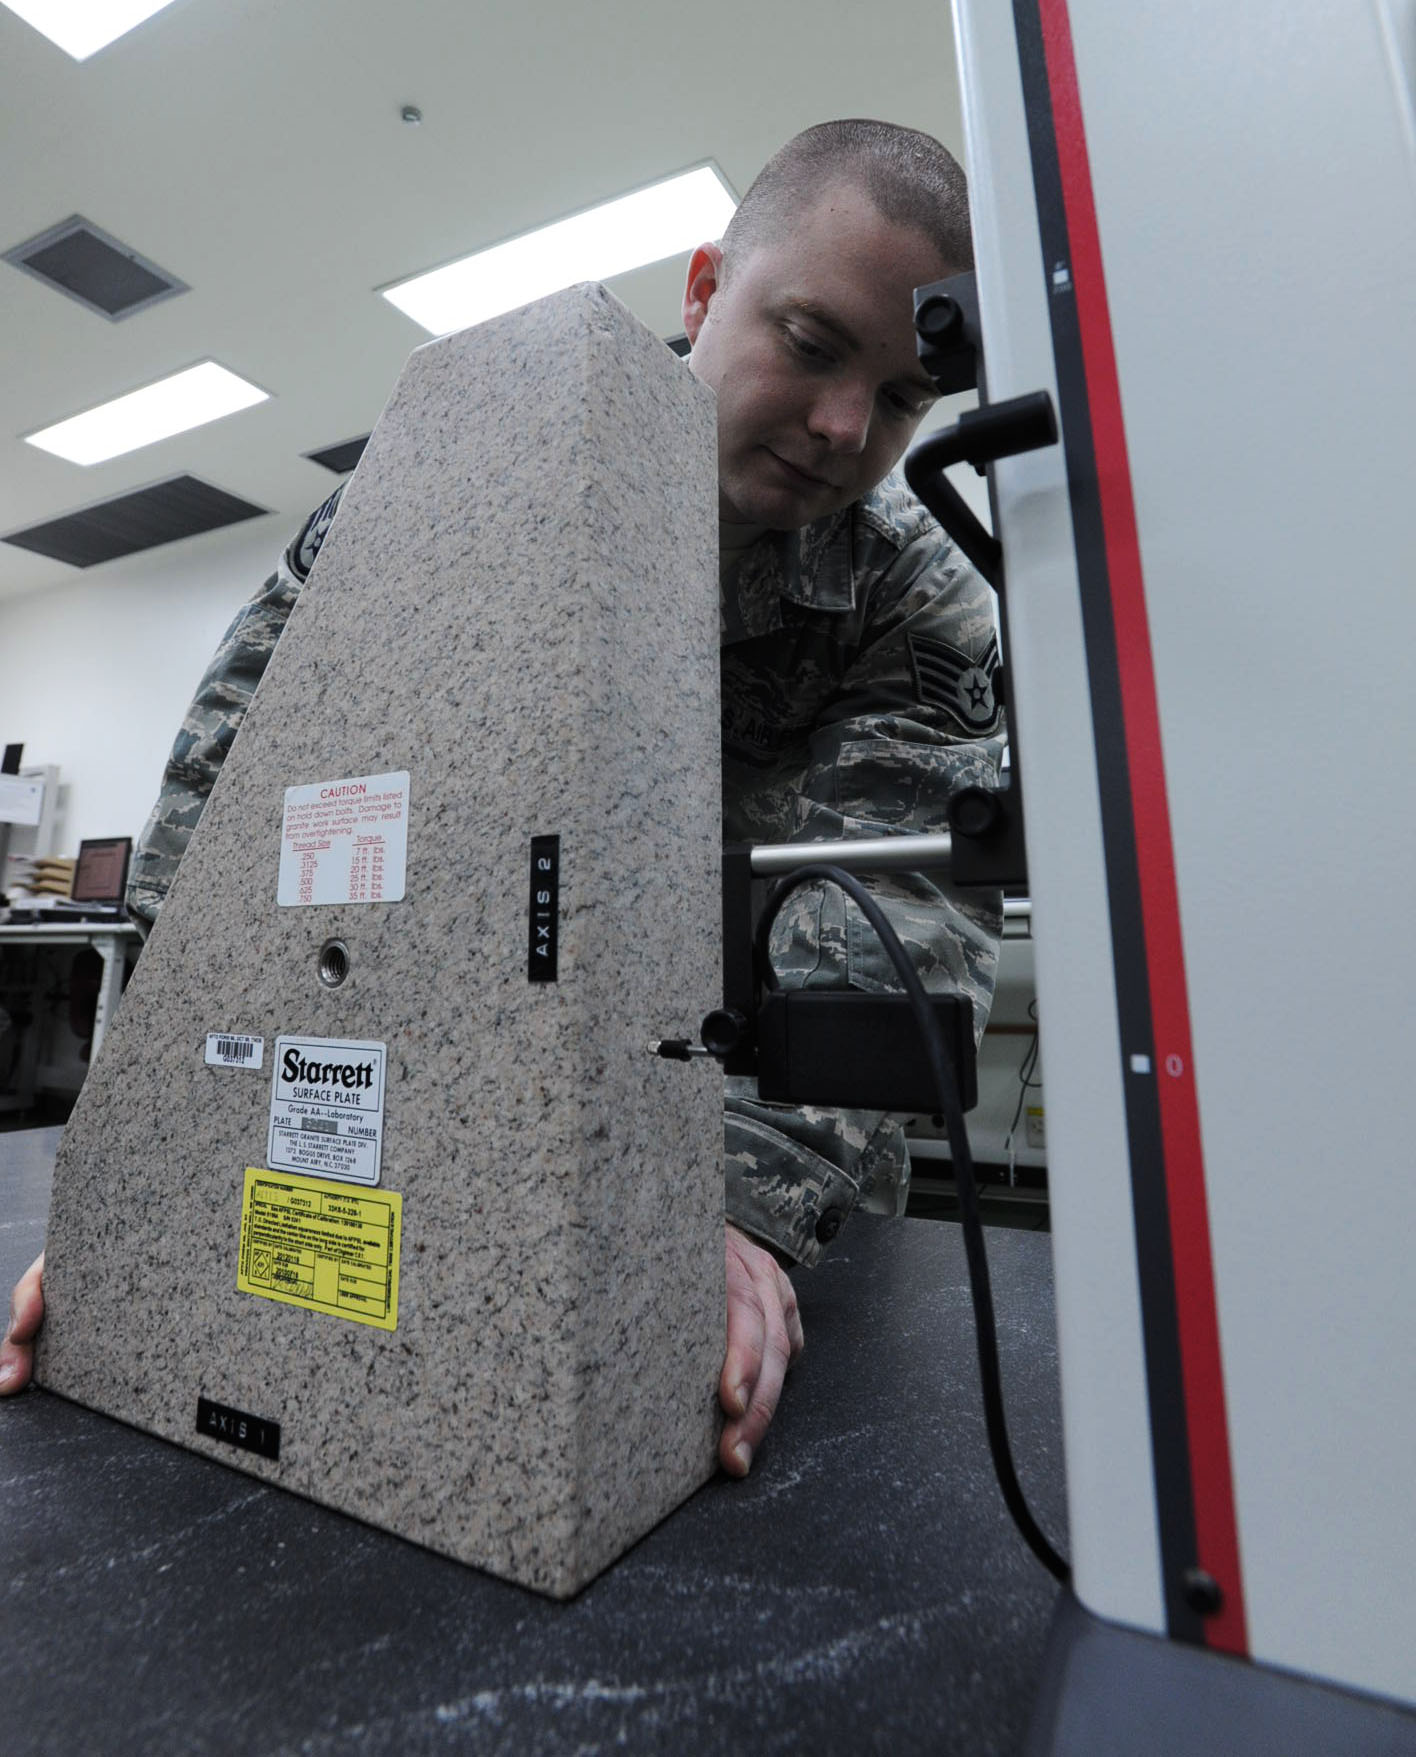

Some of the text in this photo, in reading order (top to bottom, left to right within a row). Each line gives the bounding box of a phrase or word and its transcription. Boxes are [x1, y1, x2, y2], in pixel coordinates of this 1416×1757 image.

[320, 784, 366, 798] CAUTION
[536, 857, 551, 957] AXIS 2
[282, 1048, 373, 1089] Starrett
[293, 1087, 360, 1105] SURFACE PLATE
[288, 1104, 307, 1115] Grade
[274, 1116, 292, 1126] PLATE
[348, 1126, 377, 1137] NUMBER
[308, 1142, 329, 1151] STARRETT
[330, 1145, 355, 1154] COMPANY
[292, 1156, 308, 1164] MOUNT
[209, 1411, 248, 1438] AXIS
